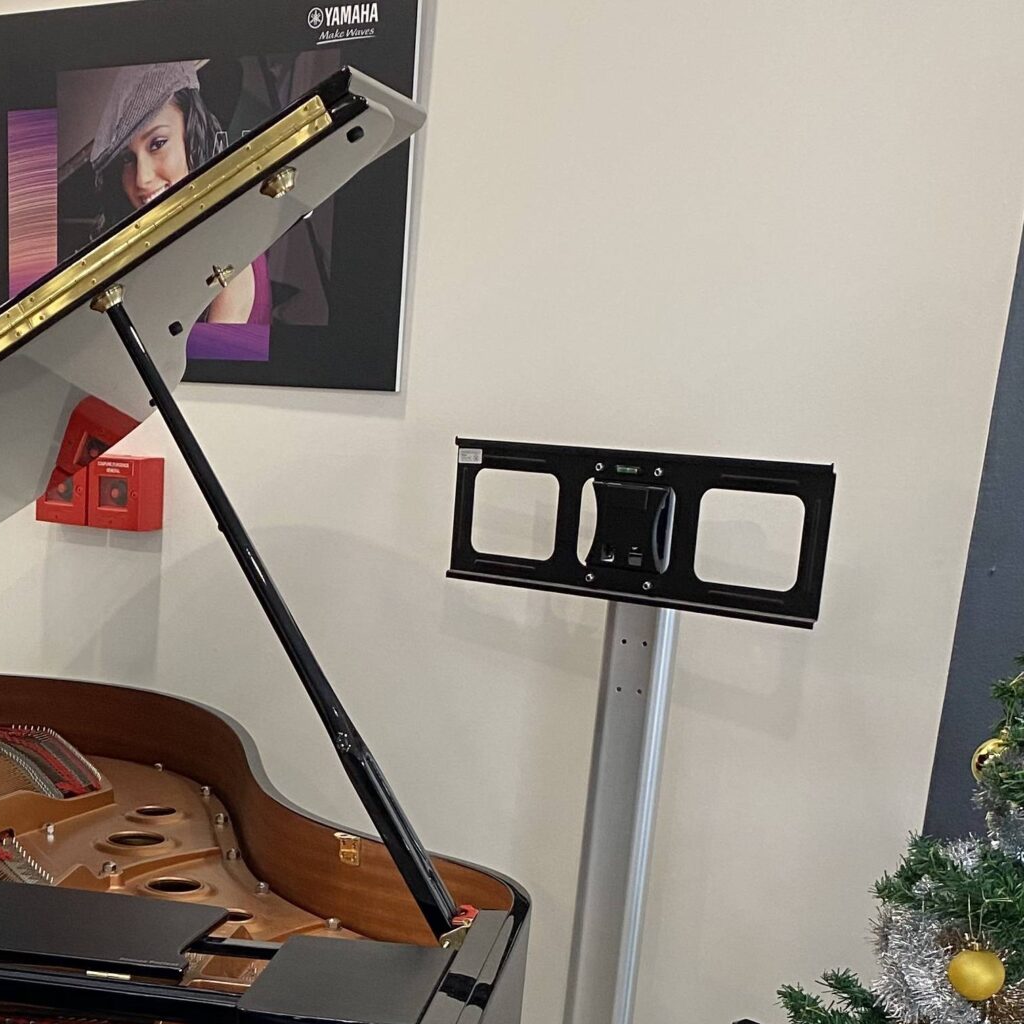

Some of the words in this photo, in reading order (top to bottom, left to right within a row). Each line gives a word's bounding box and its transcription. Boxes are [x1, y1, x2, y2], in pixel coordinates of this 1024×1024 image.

[324, 2, 378, 27] YAMAHA
[318, 29, 344, 40] Make
[346, 27, 375, 37] Waves
